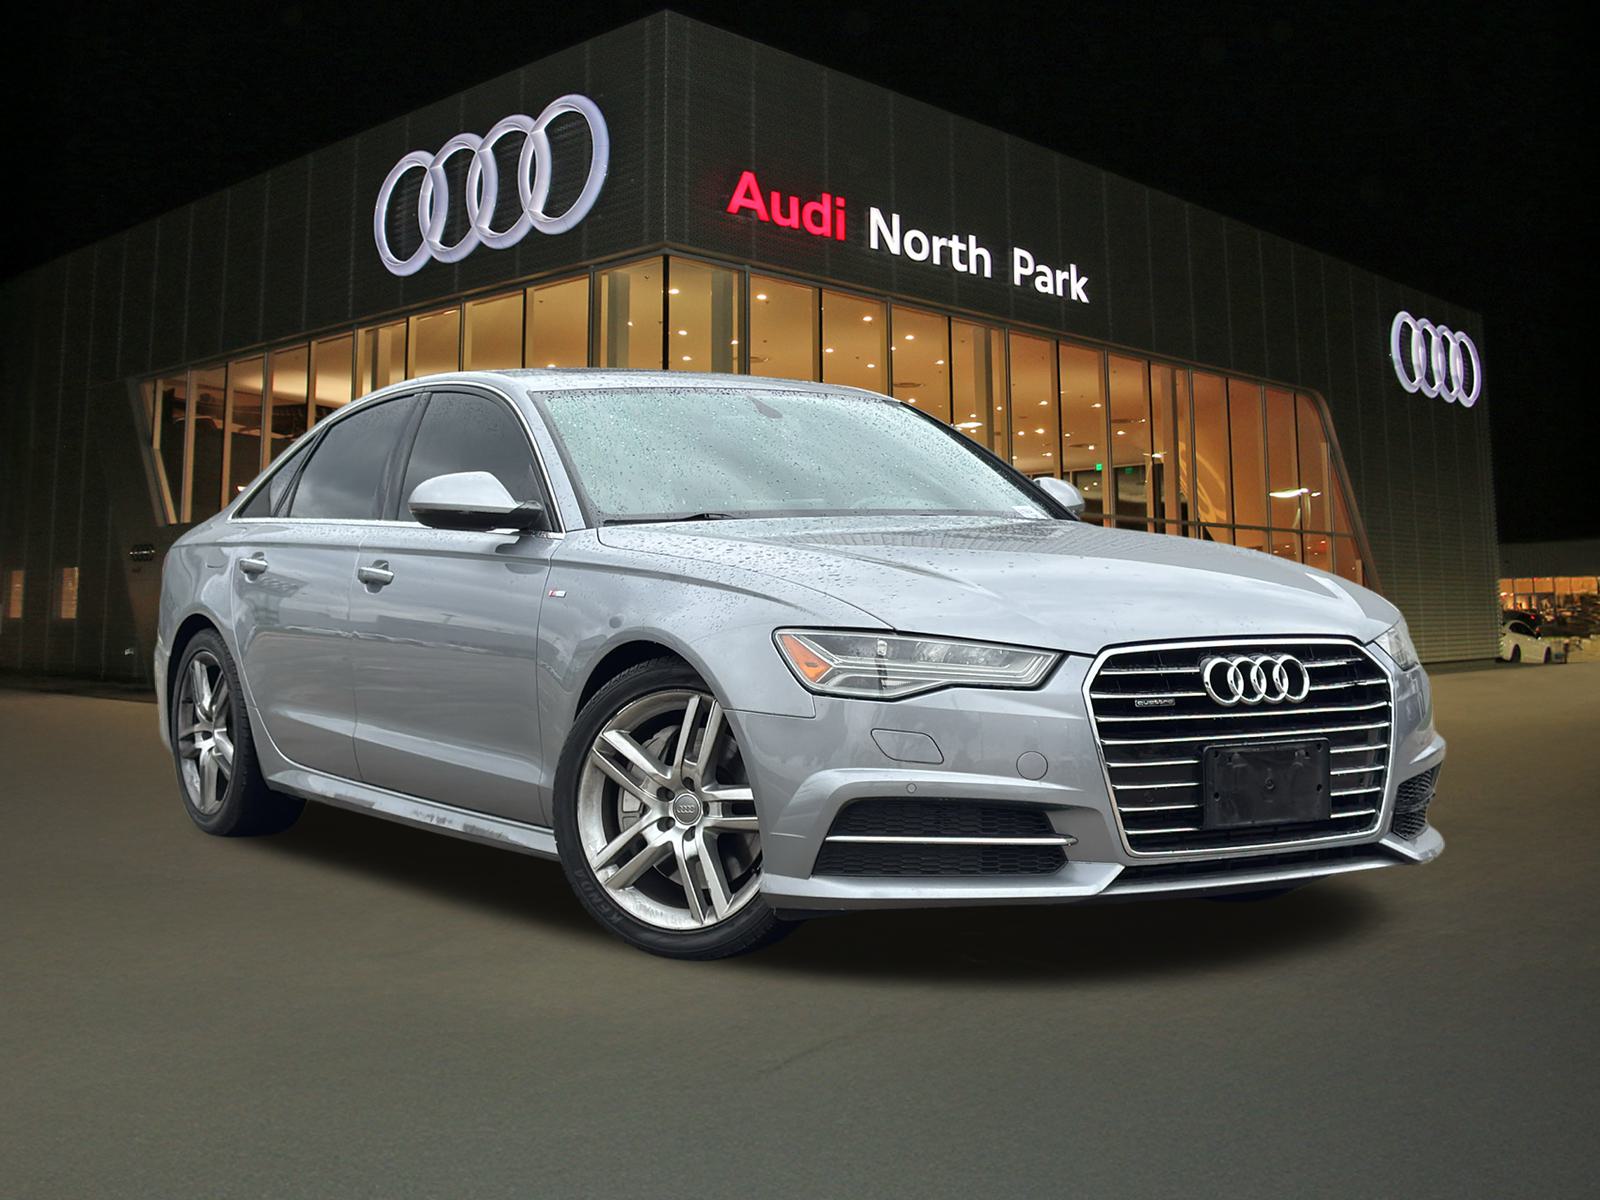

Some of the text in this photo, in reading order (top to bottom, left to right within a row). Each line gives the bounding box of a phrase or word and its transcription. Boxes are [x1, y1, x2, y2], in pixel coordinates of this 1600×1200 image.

[726, 170, 1090, 304] Audi North Park
